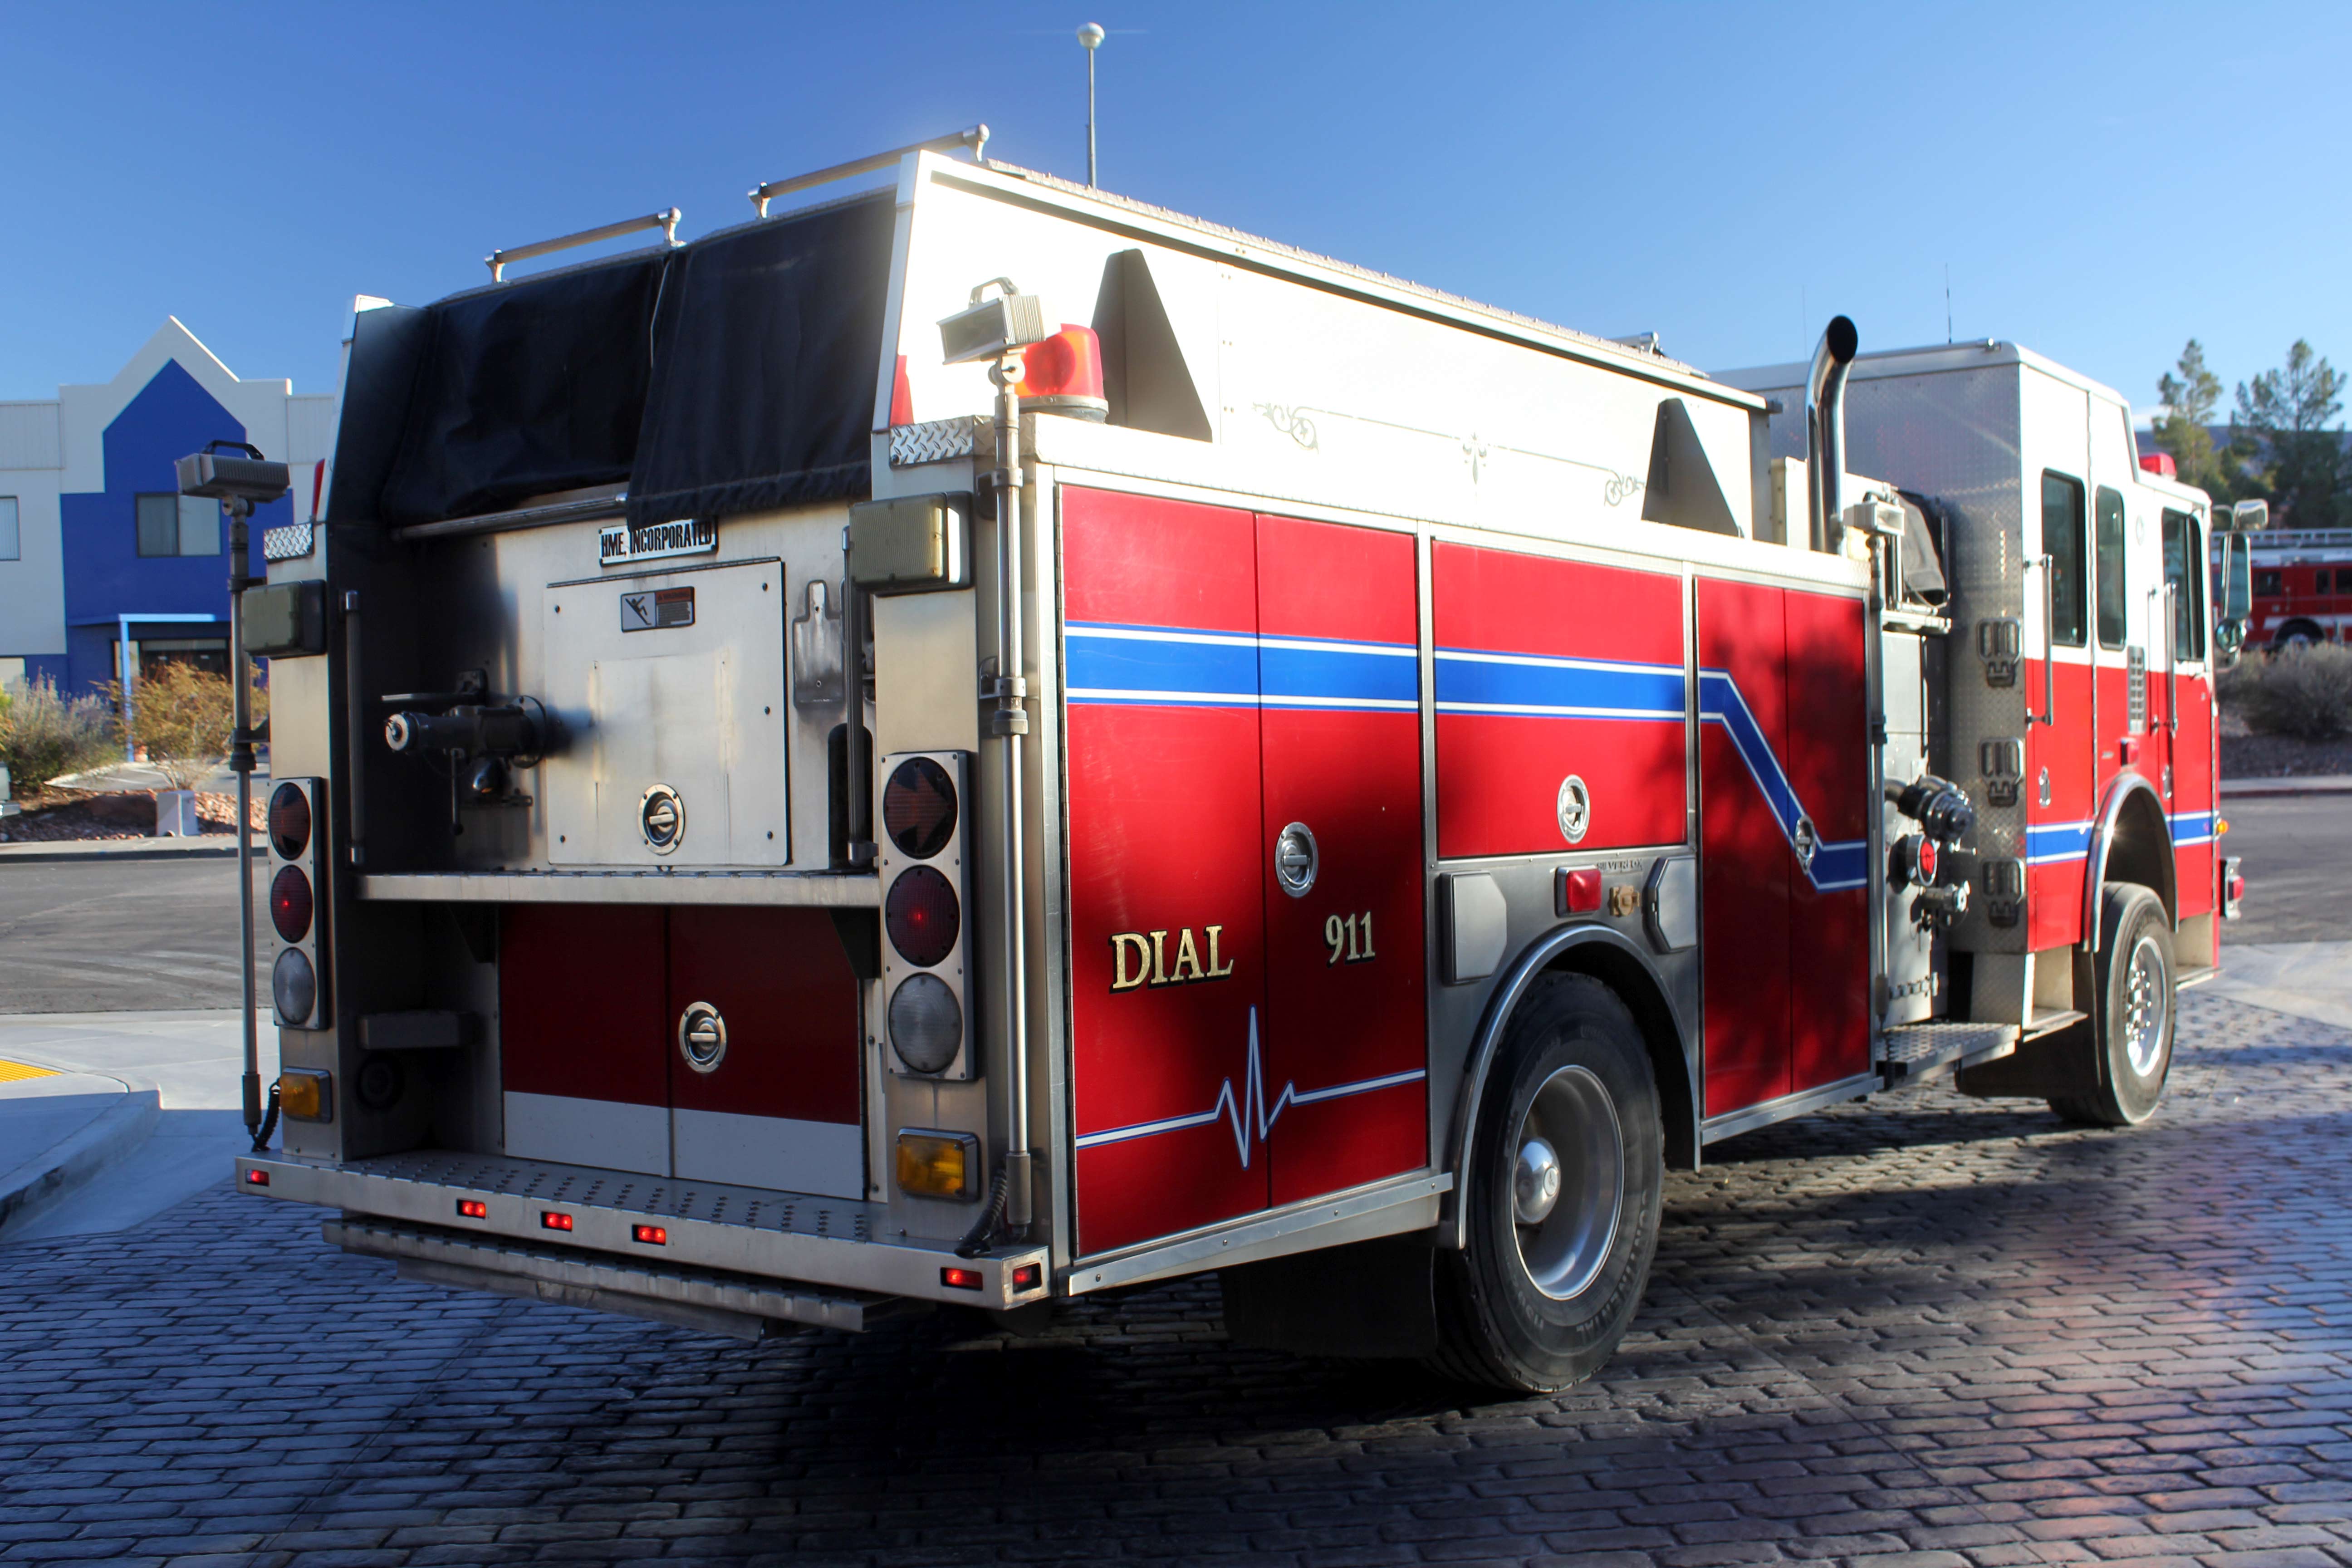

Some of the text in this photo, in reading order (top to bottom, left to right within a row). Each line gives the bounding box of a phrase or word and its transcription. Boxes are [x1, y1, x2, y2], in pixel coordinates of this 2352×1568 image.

[601, 520, 712, 557] HME, INCORPORATED
[1109, 911, 1376, 994] DIAL 911
